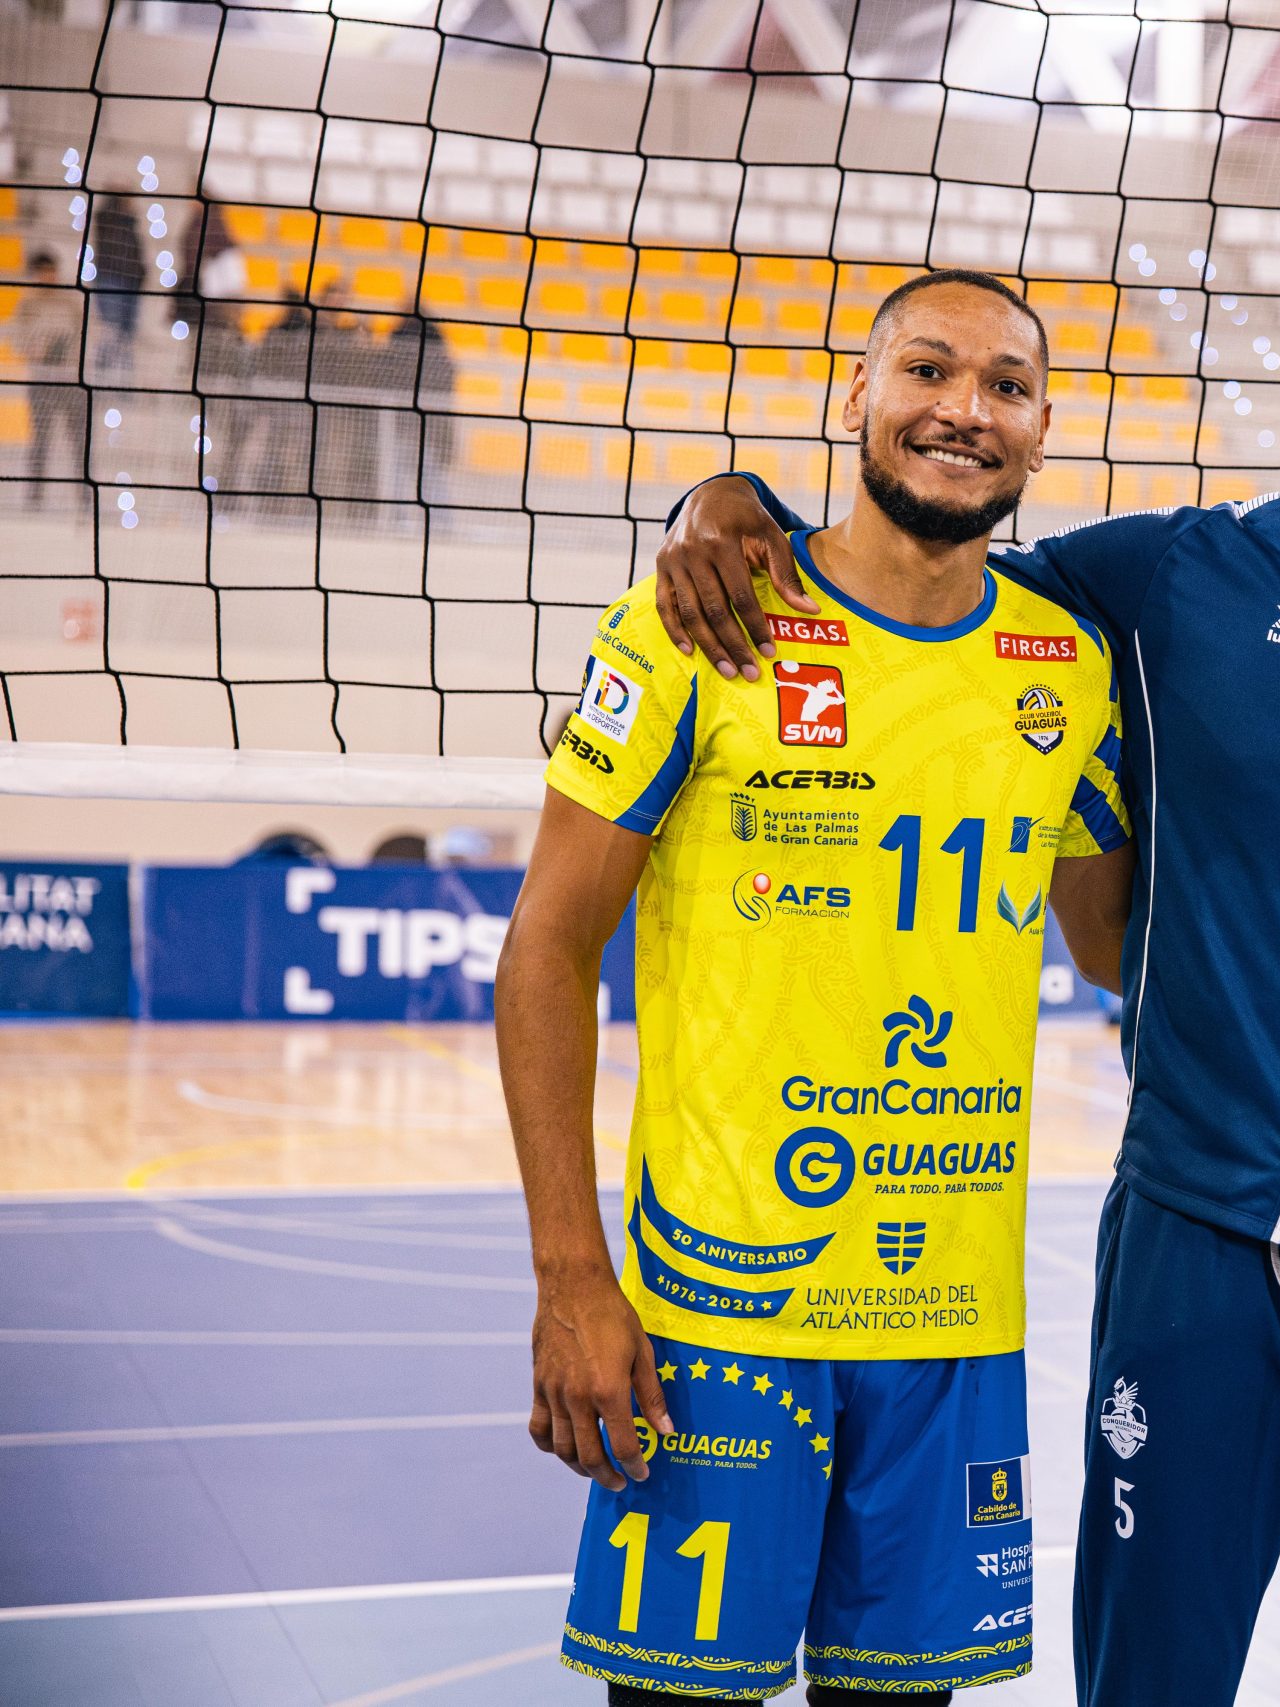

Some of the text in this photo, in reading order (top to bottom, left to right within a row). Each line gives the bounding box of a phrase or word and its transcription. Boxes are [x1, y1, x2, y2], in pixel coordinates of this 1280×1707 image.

[767, 618, 847, 642] IRGAS.
[611, 637, 655, 674] Canarias
[1000, 637, 1076, 657] FIRGAS.
[591, 713, 622, 736] DEPORTES
[1014, 716, 1067, 731] GUAGUAS
[1019, 710, 1062, 720] CLUB VOLEIBOL
[783, 723, 843, 743] SVM
[763, 809, 860, 822] Ayuntamiento
[764, 821, 859, 833] de Las Palmas
[765, 833, 859, 846] de Gran Canaria
[879, 814, 985, 933] 11
[775, 884, 851, 907] AFS
[775, 906, 850, 918] FORMACIÓN
[0, 911, 94, 953] ANA
[781, 1075, 1022, 1115] GranCanaria
[863, 1141, 1016, 1176] GUAGUAS
[874, 1181, 1004, 1194] PARA TODO. PARA TODOS.
[672, 1228, 807, 1265] 50 ANIVERSARIO
[664, 1280, 755, 1312] 1976-2026
[806, 1285, 978, 1306] UNIVERSIDAD DEL
[800, 1308, 979, 1329] ATLÁNTICO MEDIO
[1102, 1417, 1146, 1434] CONQUERIDOR
[662, 1431, 772, 1459] GUAGUAS
[670, 1456, 759, 1470] PARA TODO. PARA TODOS.
[973, 1509, 1021, 1522] Gran Canaria
[978, 1501, 1017, 1514] Cabildo de
[1114, 1476, 1135, 1539] 5
[609, 1512, 730, 1642] 11
[1002, 1558, 1026, 1576] SAN
